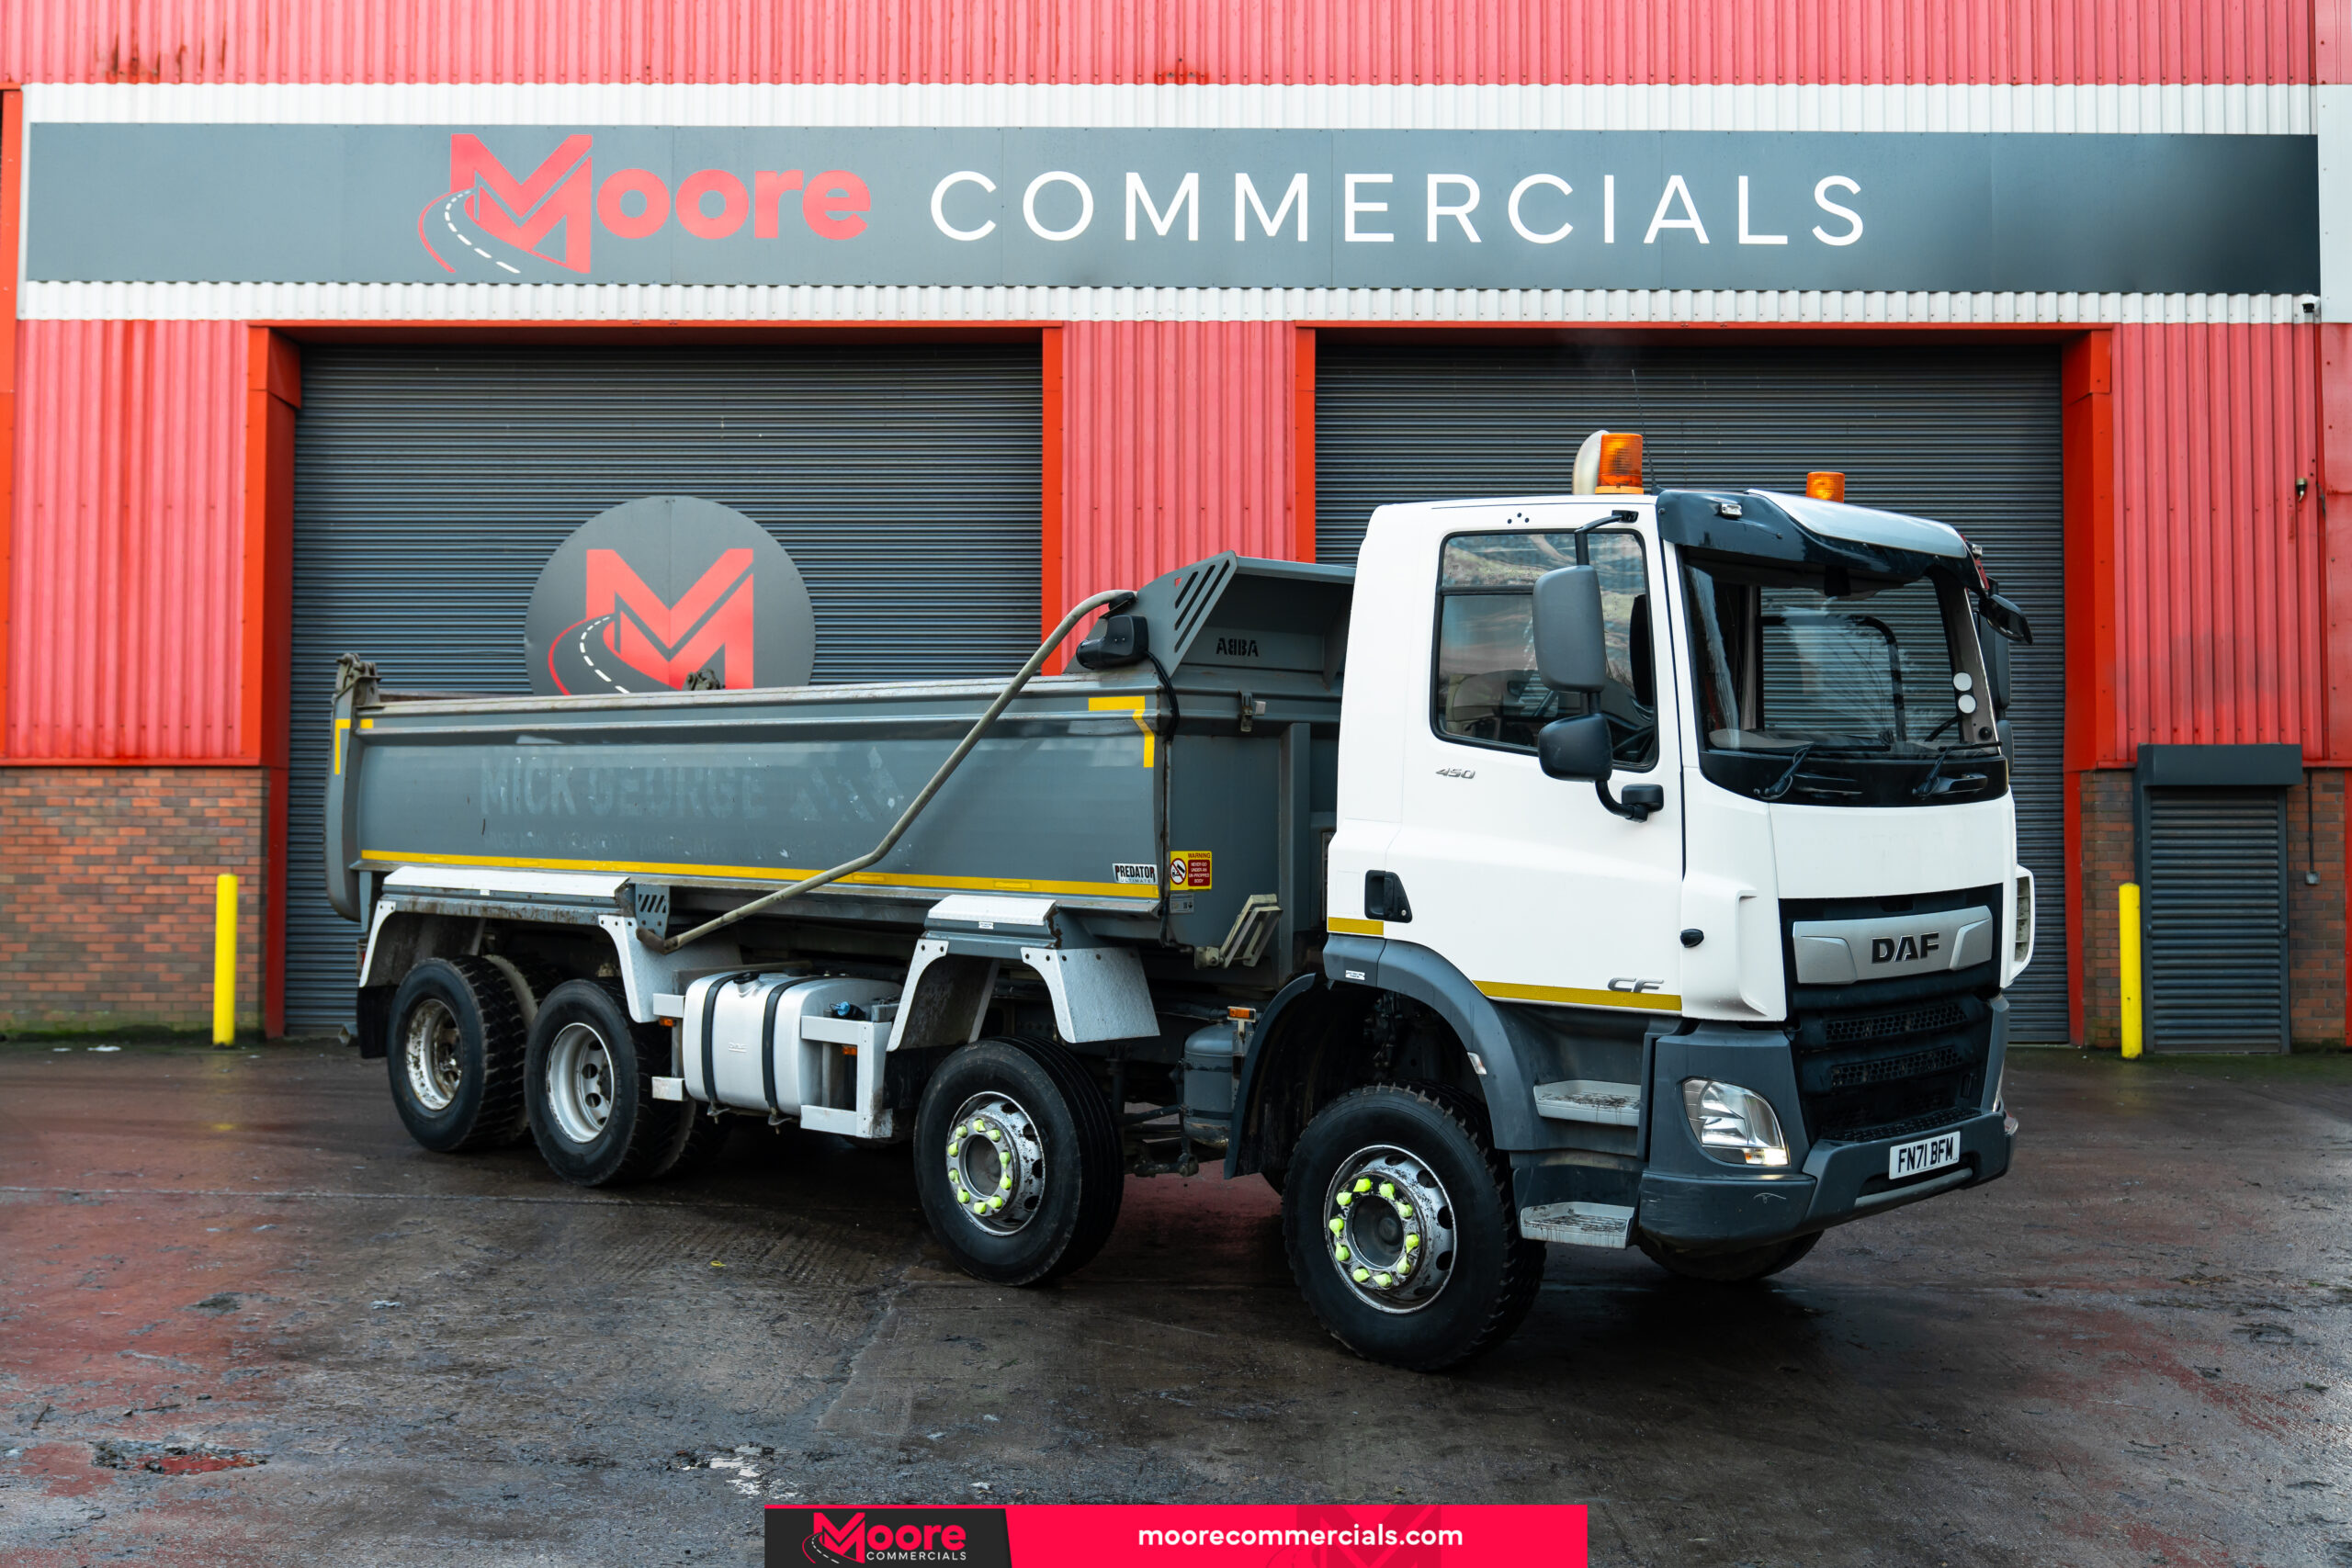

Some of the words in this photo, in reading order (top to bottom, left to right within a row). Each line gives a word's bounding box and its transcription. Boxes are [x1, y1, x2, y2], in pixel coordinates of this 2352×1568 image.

[449, 132, 872, 274] Moore
[930, 170, 1865, 247] COMMERCIALS
[1216, 637, 1259, 658] ABBA
[1435, 768, 1476, 779] 450
[1114, 865, 1156, 883] PREDATOR
[1871, 932, 1940, 964] DAF
[1608, 976, 1665, 993] CF
[1897, 1143, 1928, 1173] FN71
[1930, 1136, 1954, 1166] BFM
